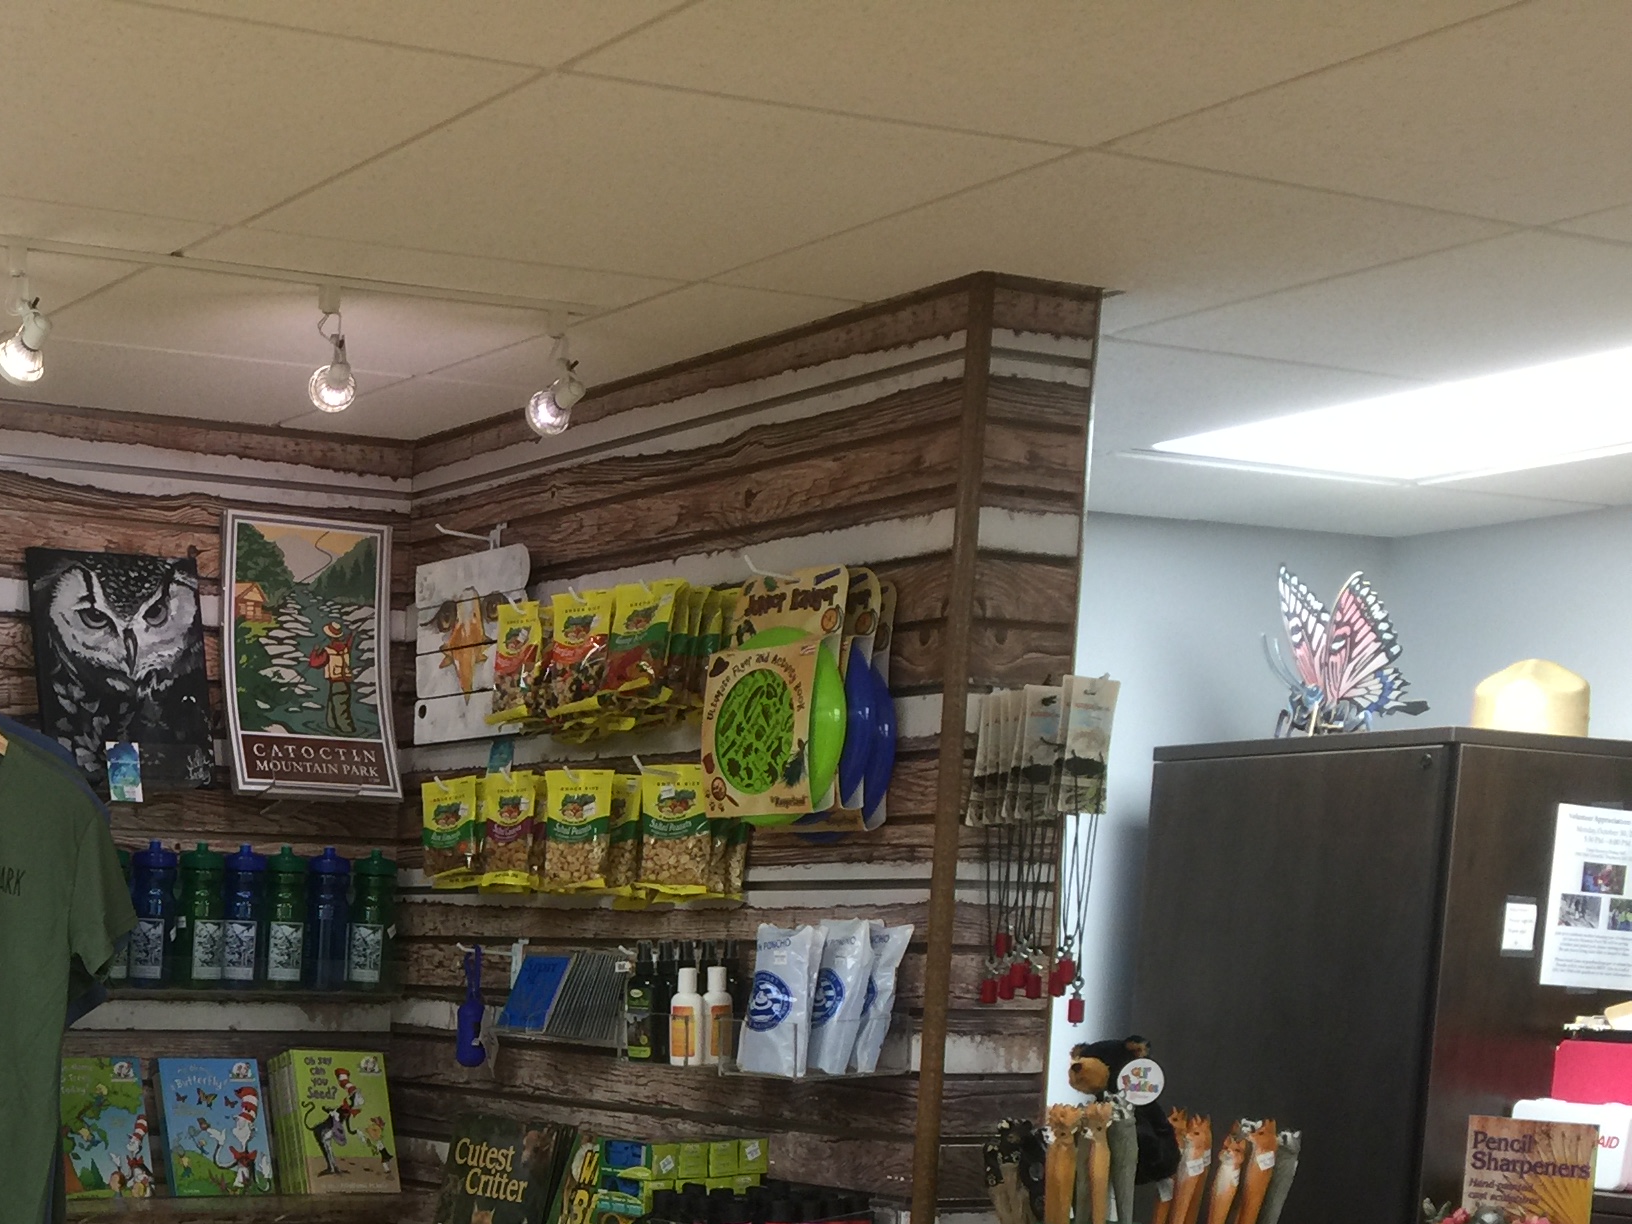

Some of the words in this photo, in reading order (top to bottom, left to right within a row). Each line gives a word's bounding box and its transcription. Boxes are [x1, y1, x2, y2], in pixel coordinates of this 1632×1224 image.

[252, 742, 376, 763] CATOCTIN
[255, 759, 339, 775] MOUNTAIN
[342, 763, 379, 778] PARK
[1472, 1130, 1534, 1153] Pencil
[1598, 1135, 1620, 1149] AID
[455, 1137, 516, 1173] Cutest
[1470, 1150, 1591, 1179] Sharpeners
[465, 1168, 528, 1203] Critter
